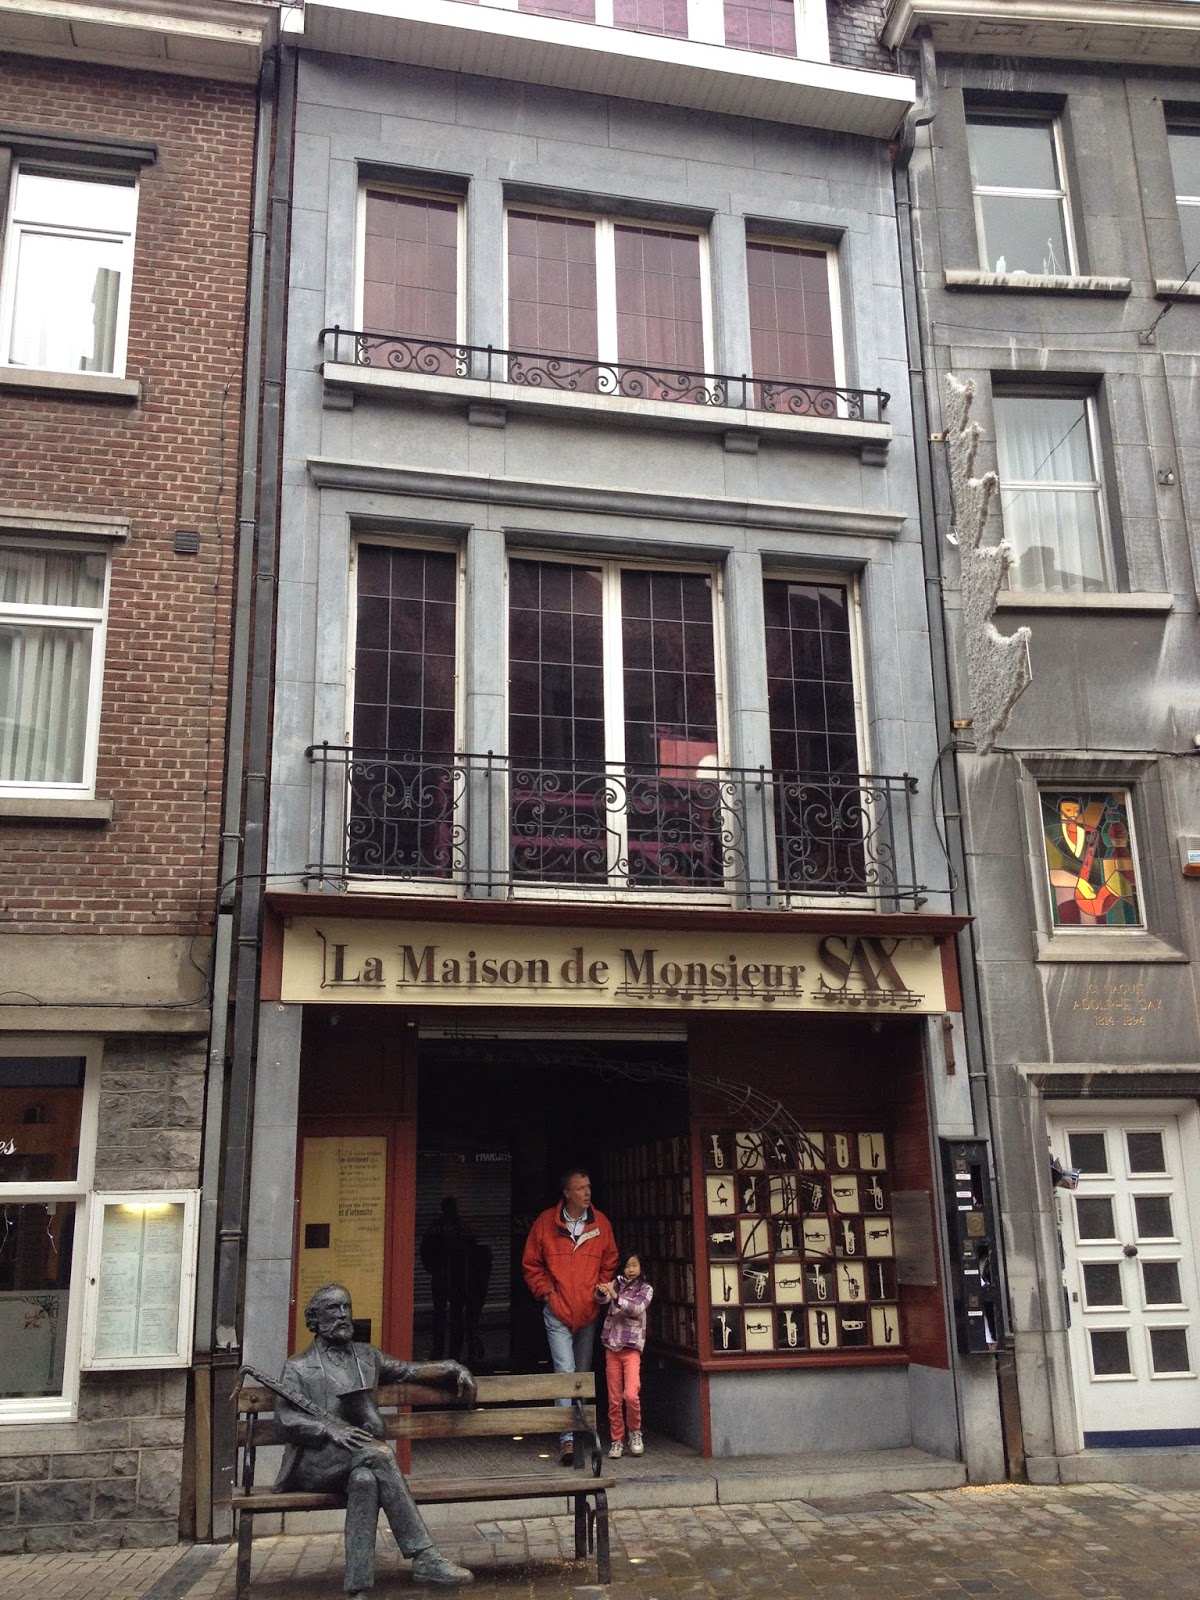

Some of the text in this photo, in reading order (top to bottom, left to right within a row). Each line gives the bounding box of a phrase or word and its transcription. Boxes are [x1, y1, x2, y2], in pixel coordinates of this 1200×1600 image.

[331, 935, 915, 992] La Maison de Monsieur SAX
[1072, 998, 1164, 1011] ADOLPHE SAX
